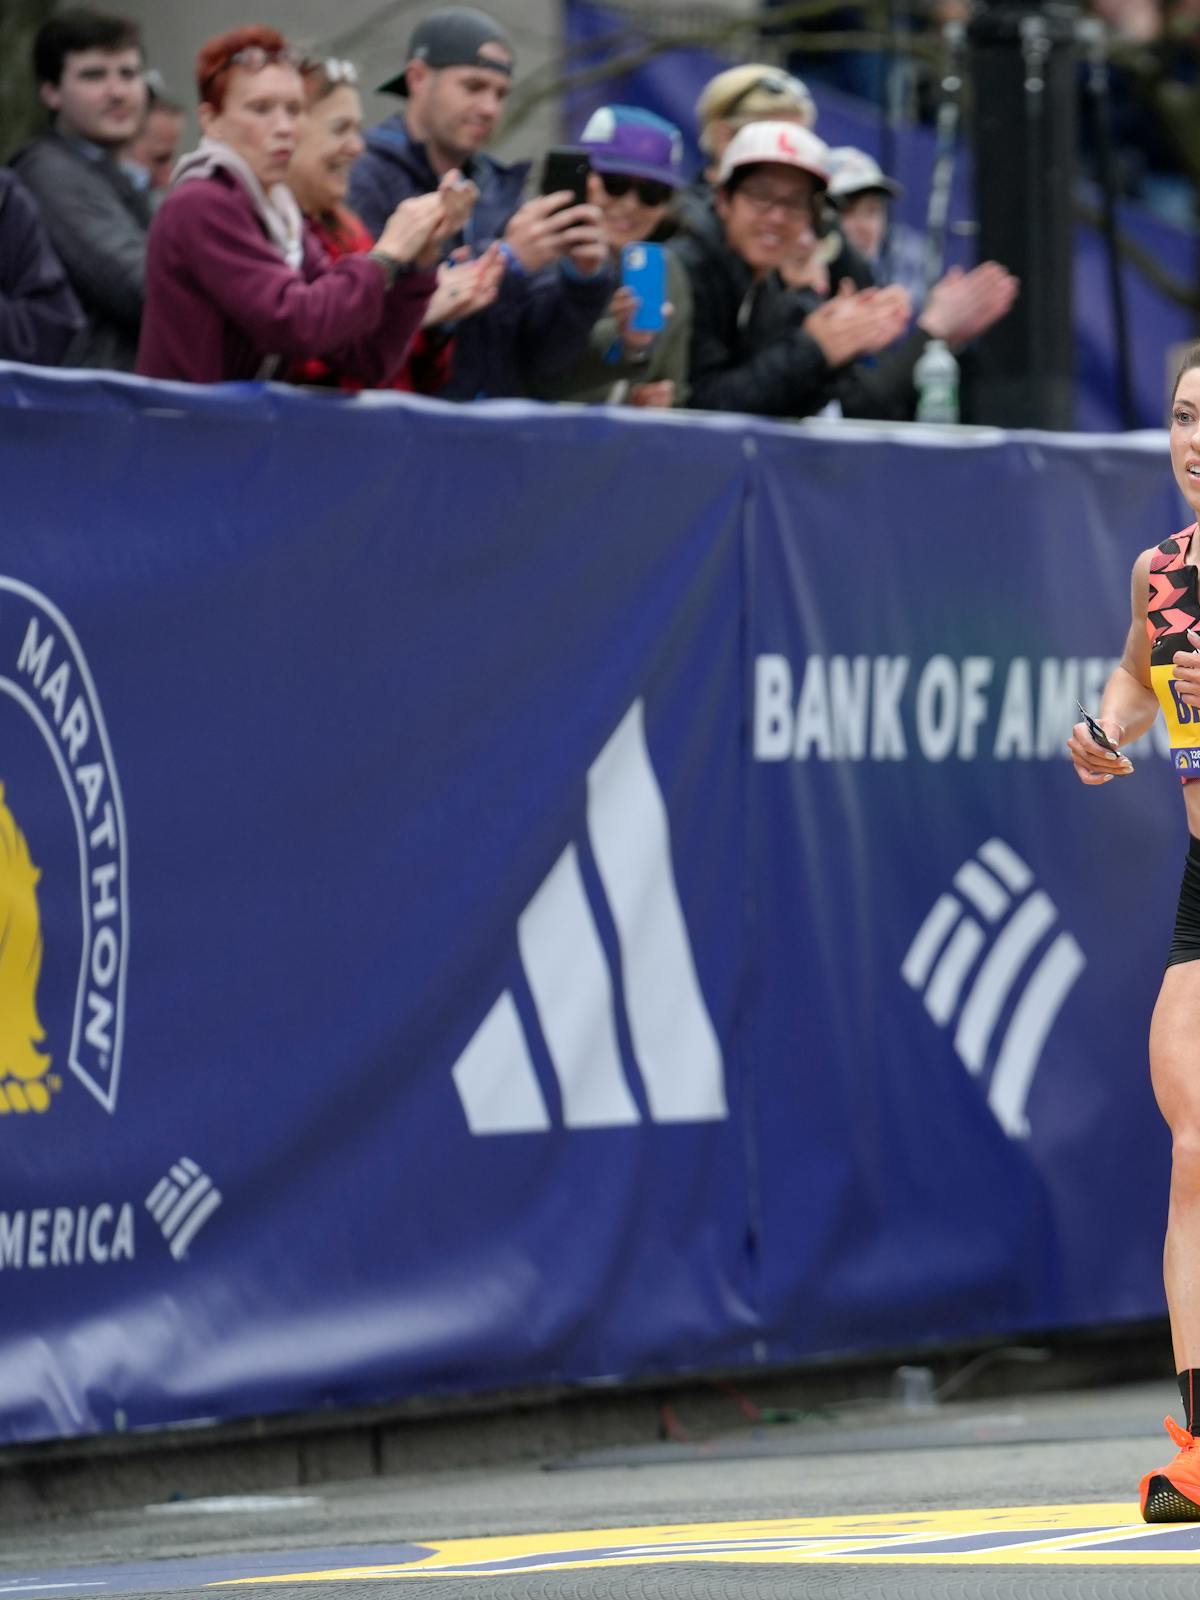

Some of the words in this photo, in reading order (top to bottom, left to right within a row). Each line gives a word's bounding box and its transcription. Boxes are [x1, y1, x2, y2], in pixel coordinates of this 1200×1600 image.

[753, 652, 908, 763] BANK
[915, 653, 994, 763] OF
[17, 616, 118, 1056] MARATHON
[0, 1202, 136, 1271] MERICA
